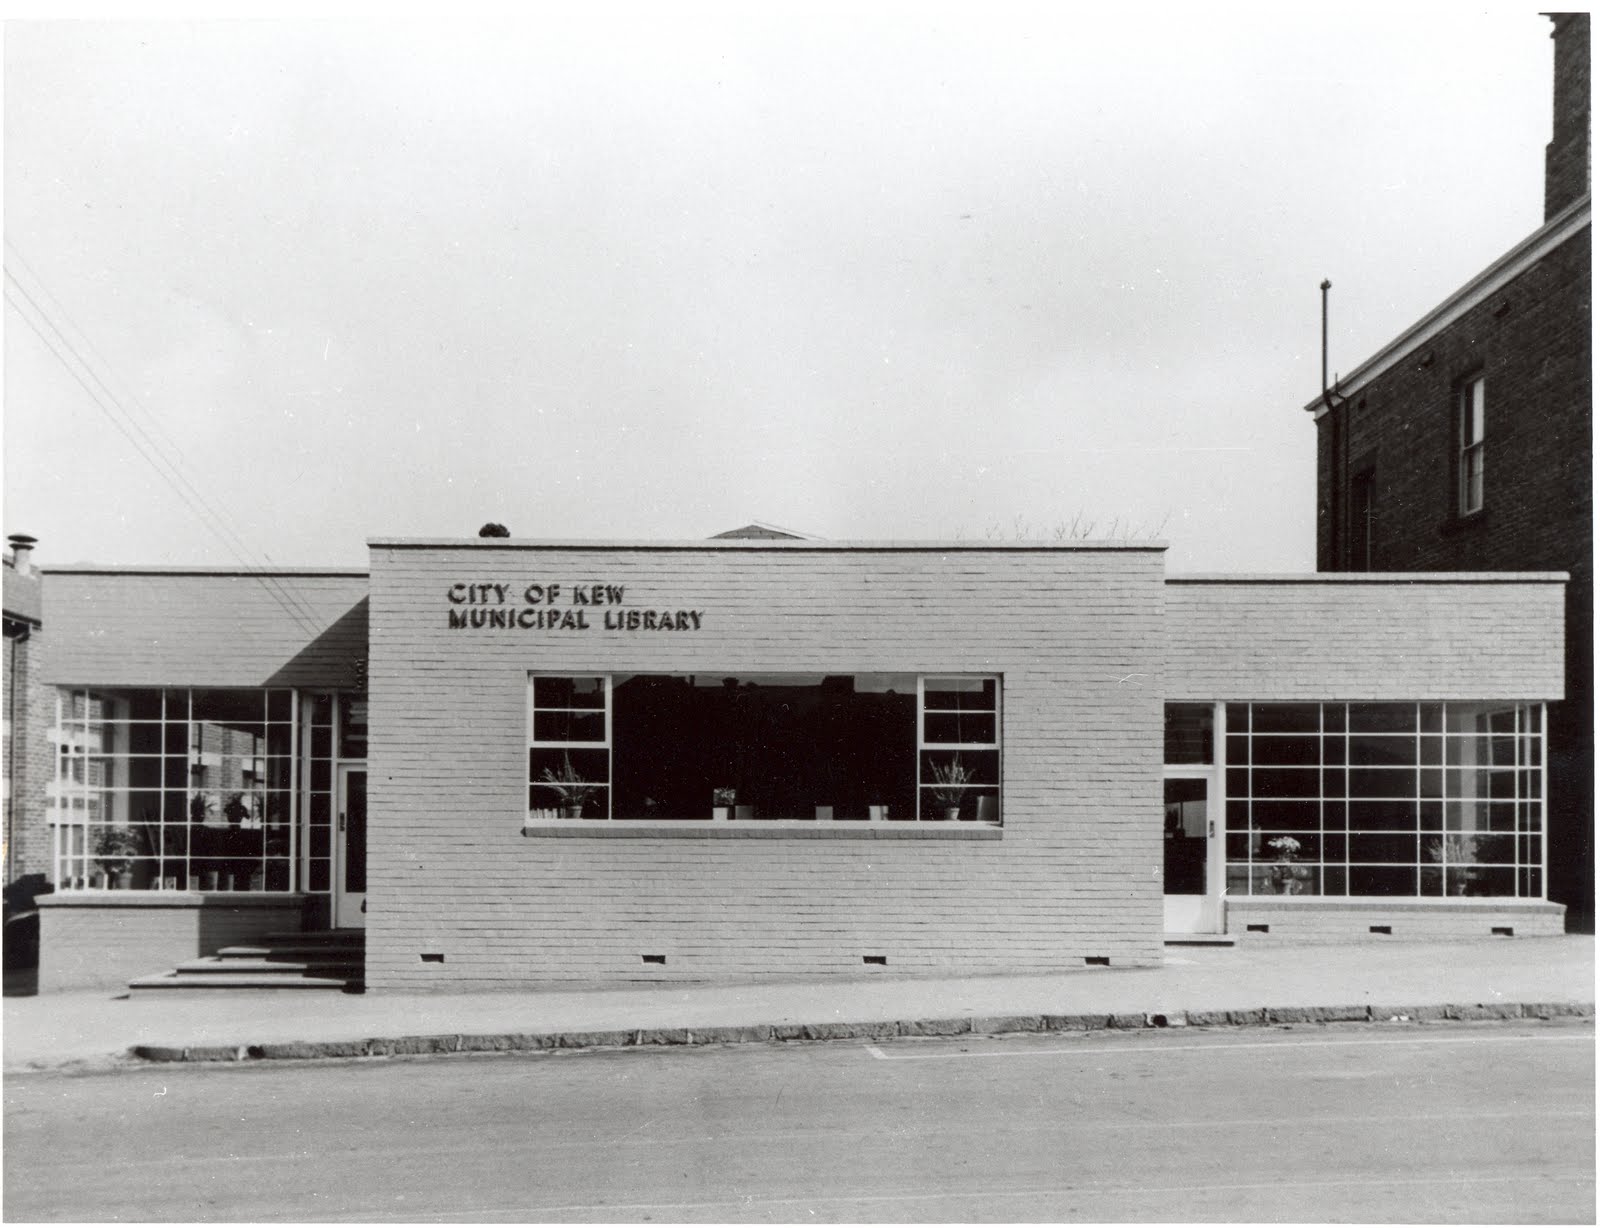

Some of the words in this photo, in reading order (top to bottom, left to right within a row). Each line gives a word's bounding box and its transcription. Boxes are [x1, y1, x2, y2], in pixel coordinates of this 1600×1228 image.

[447, 583, 509, 605] CITY
[524, 583, 560, 605] OF
[572, 584, 625, 606] KEW
[448, 608, 590, 630] MUNICIPAL
[603, 609, 704, 631] LIBRARY
